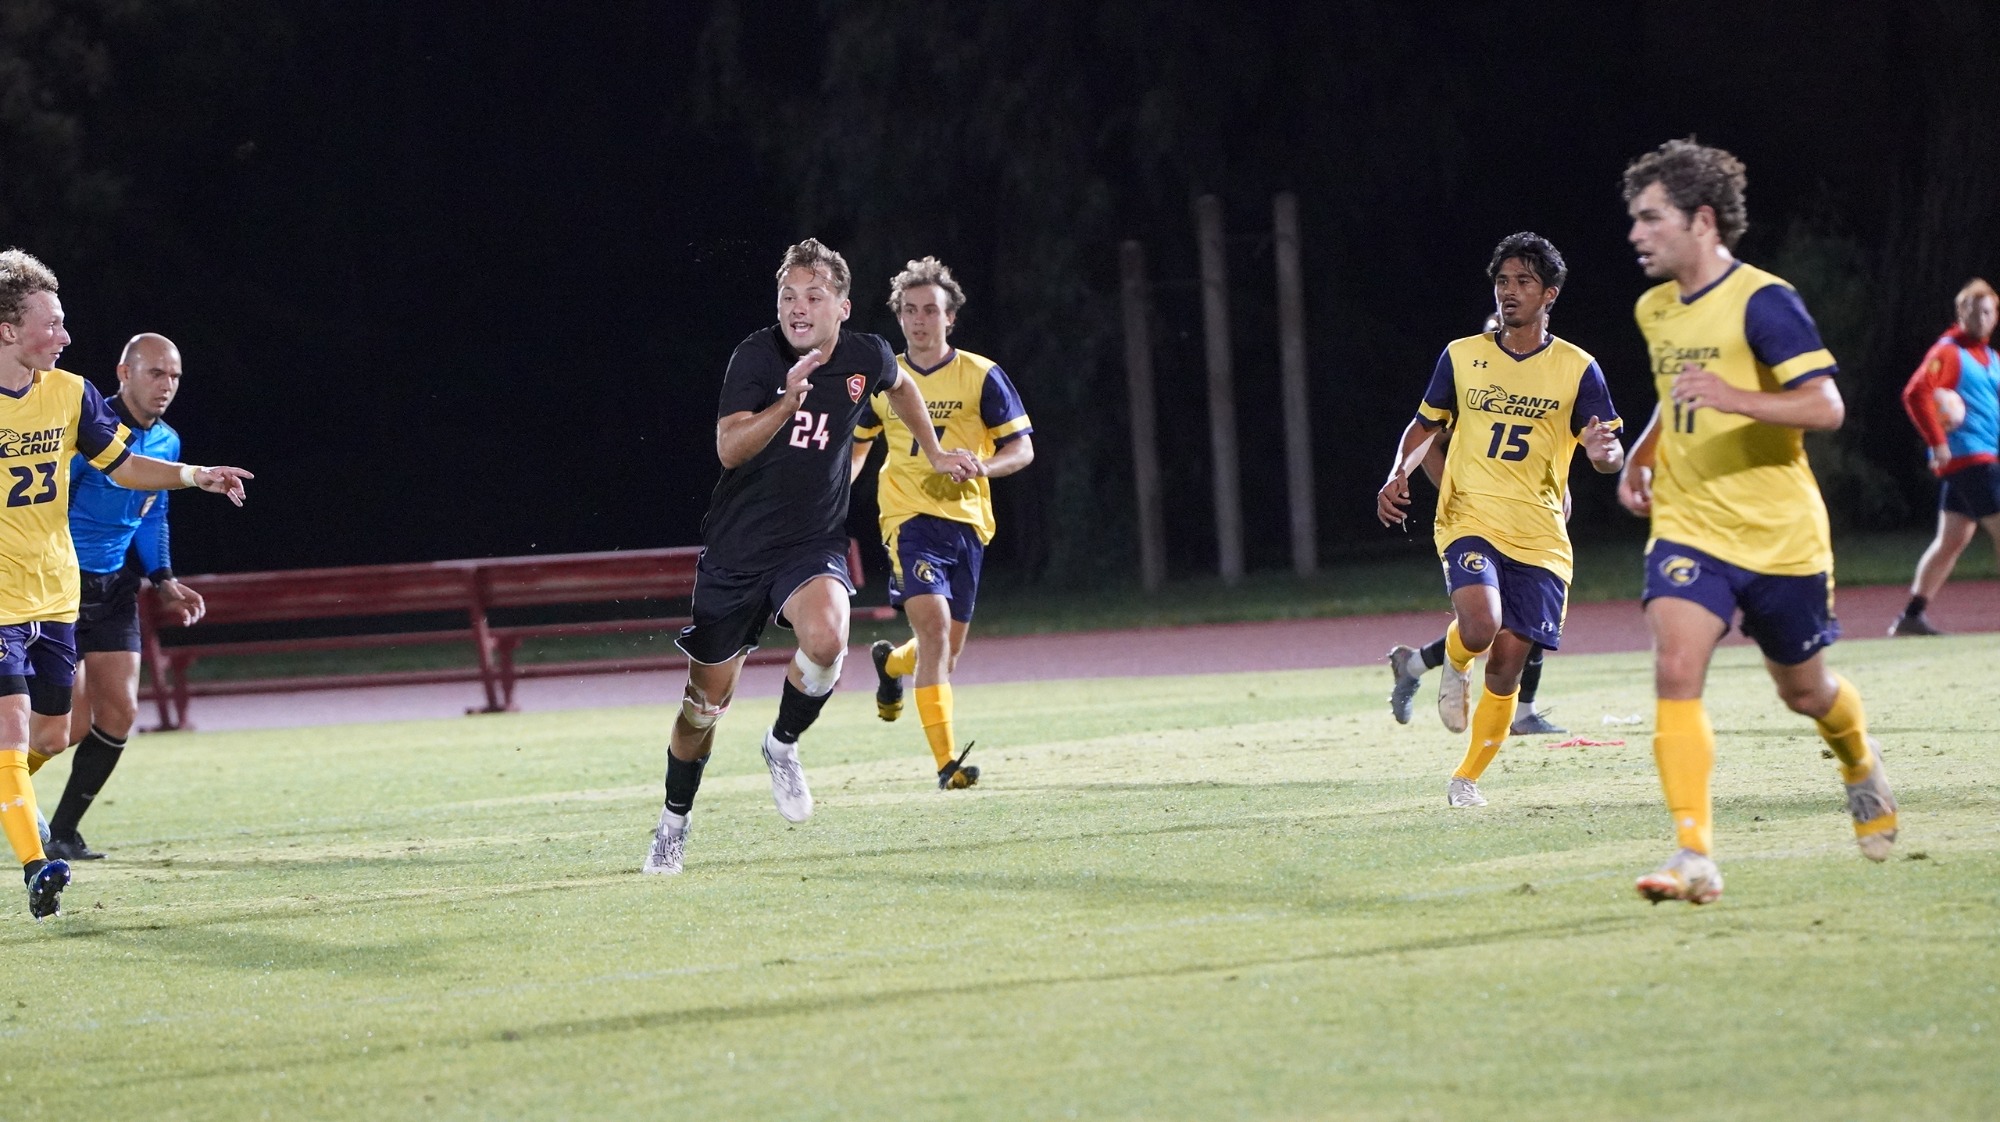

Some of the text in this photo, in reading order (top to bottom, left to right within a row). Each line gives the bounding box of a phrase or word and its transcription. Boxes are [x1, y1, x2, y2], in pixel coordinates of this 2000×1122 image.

[850, 378, 862, 396] S
[924, 401, 963, 410] ANTA
[1506, 394, 1560, 410] SANTA
[928, 410, 953, 419] RUZ
[1503, 405, 1547, 420] CRUZ
[788, 410, 830, 451] 24
[20, 440, 60, 456] CRUZ
[1487, 422, 1534, 462] 15
[6, 461, 58, 508] 23
